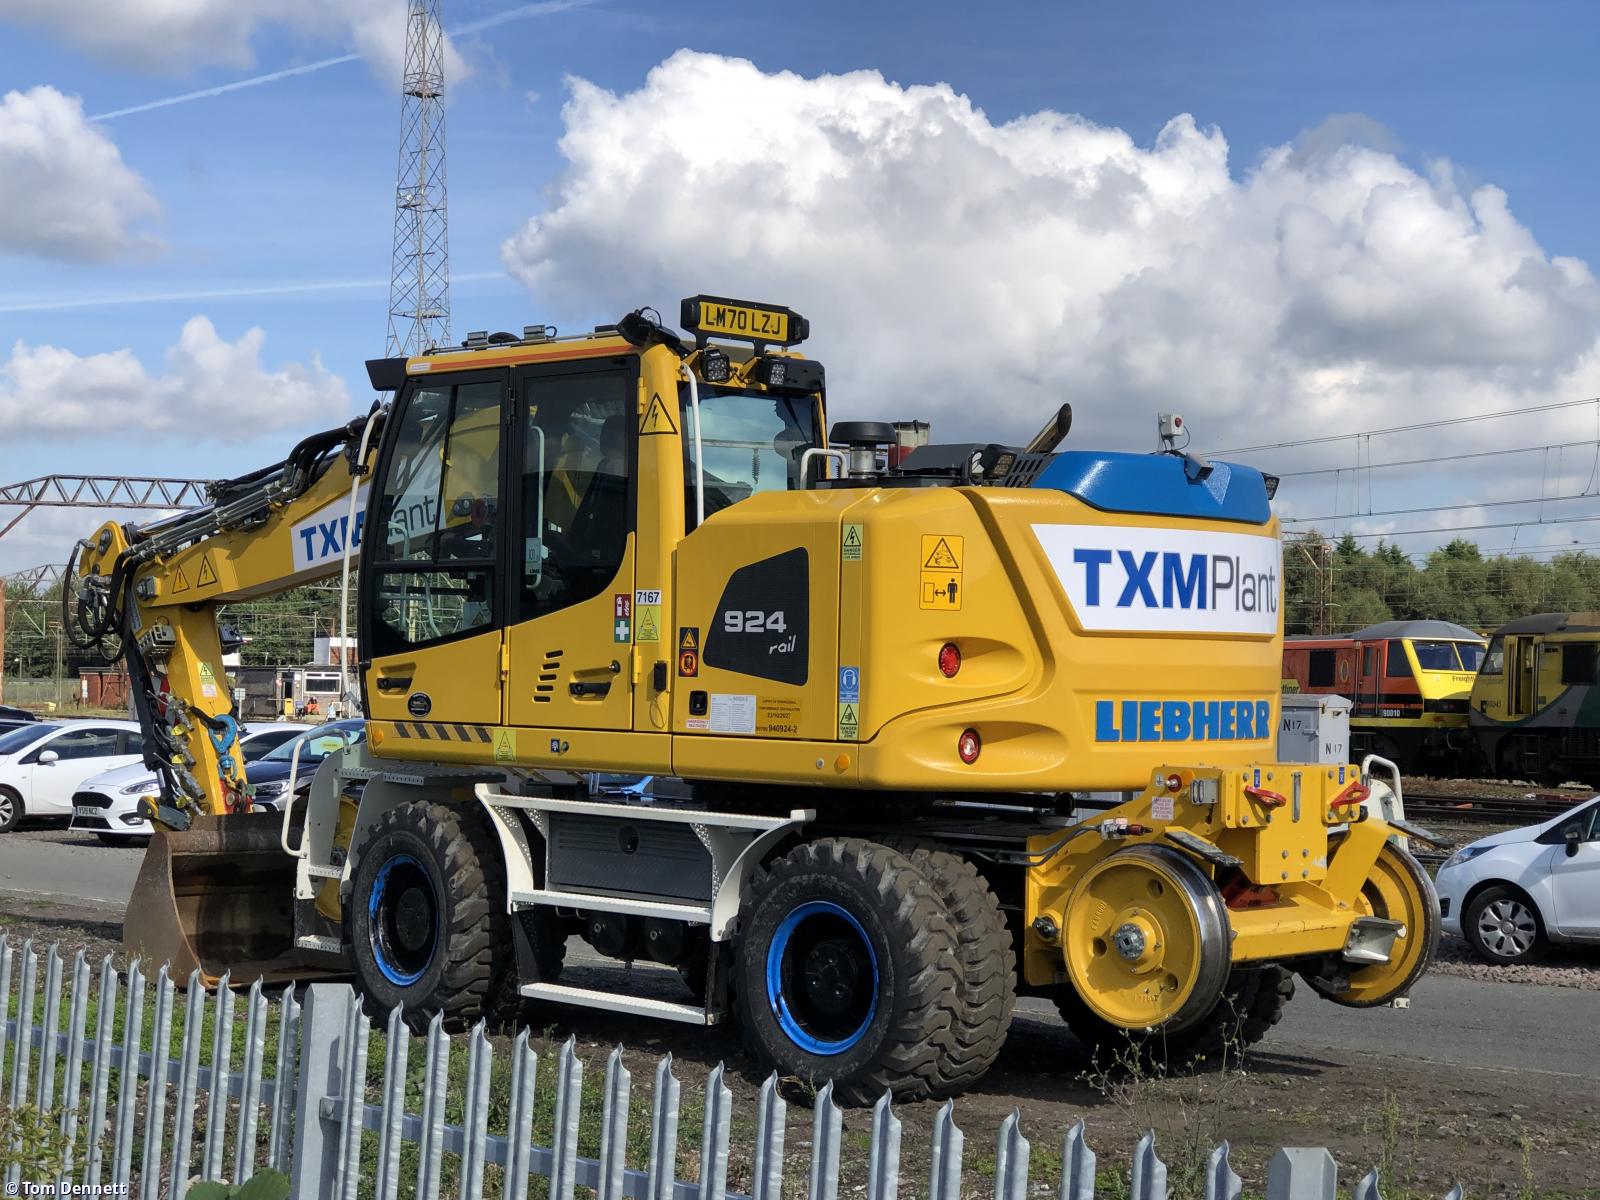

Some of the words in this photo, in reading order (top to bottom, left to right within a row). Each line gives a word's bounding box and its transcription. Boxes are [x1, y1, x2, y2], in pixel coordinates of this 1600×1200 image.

[706, 305, 747, 330] LM70
[752, 312, 780, 335] LZJ
[636, 591, 660, 603] 7167
[724, 610, 787, 633] 924
[768, 634, 797, 655] rail
[1095, 700, 1270, 743] LIEBHERR
